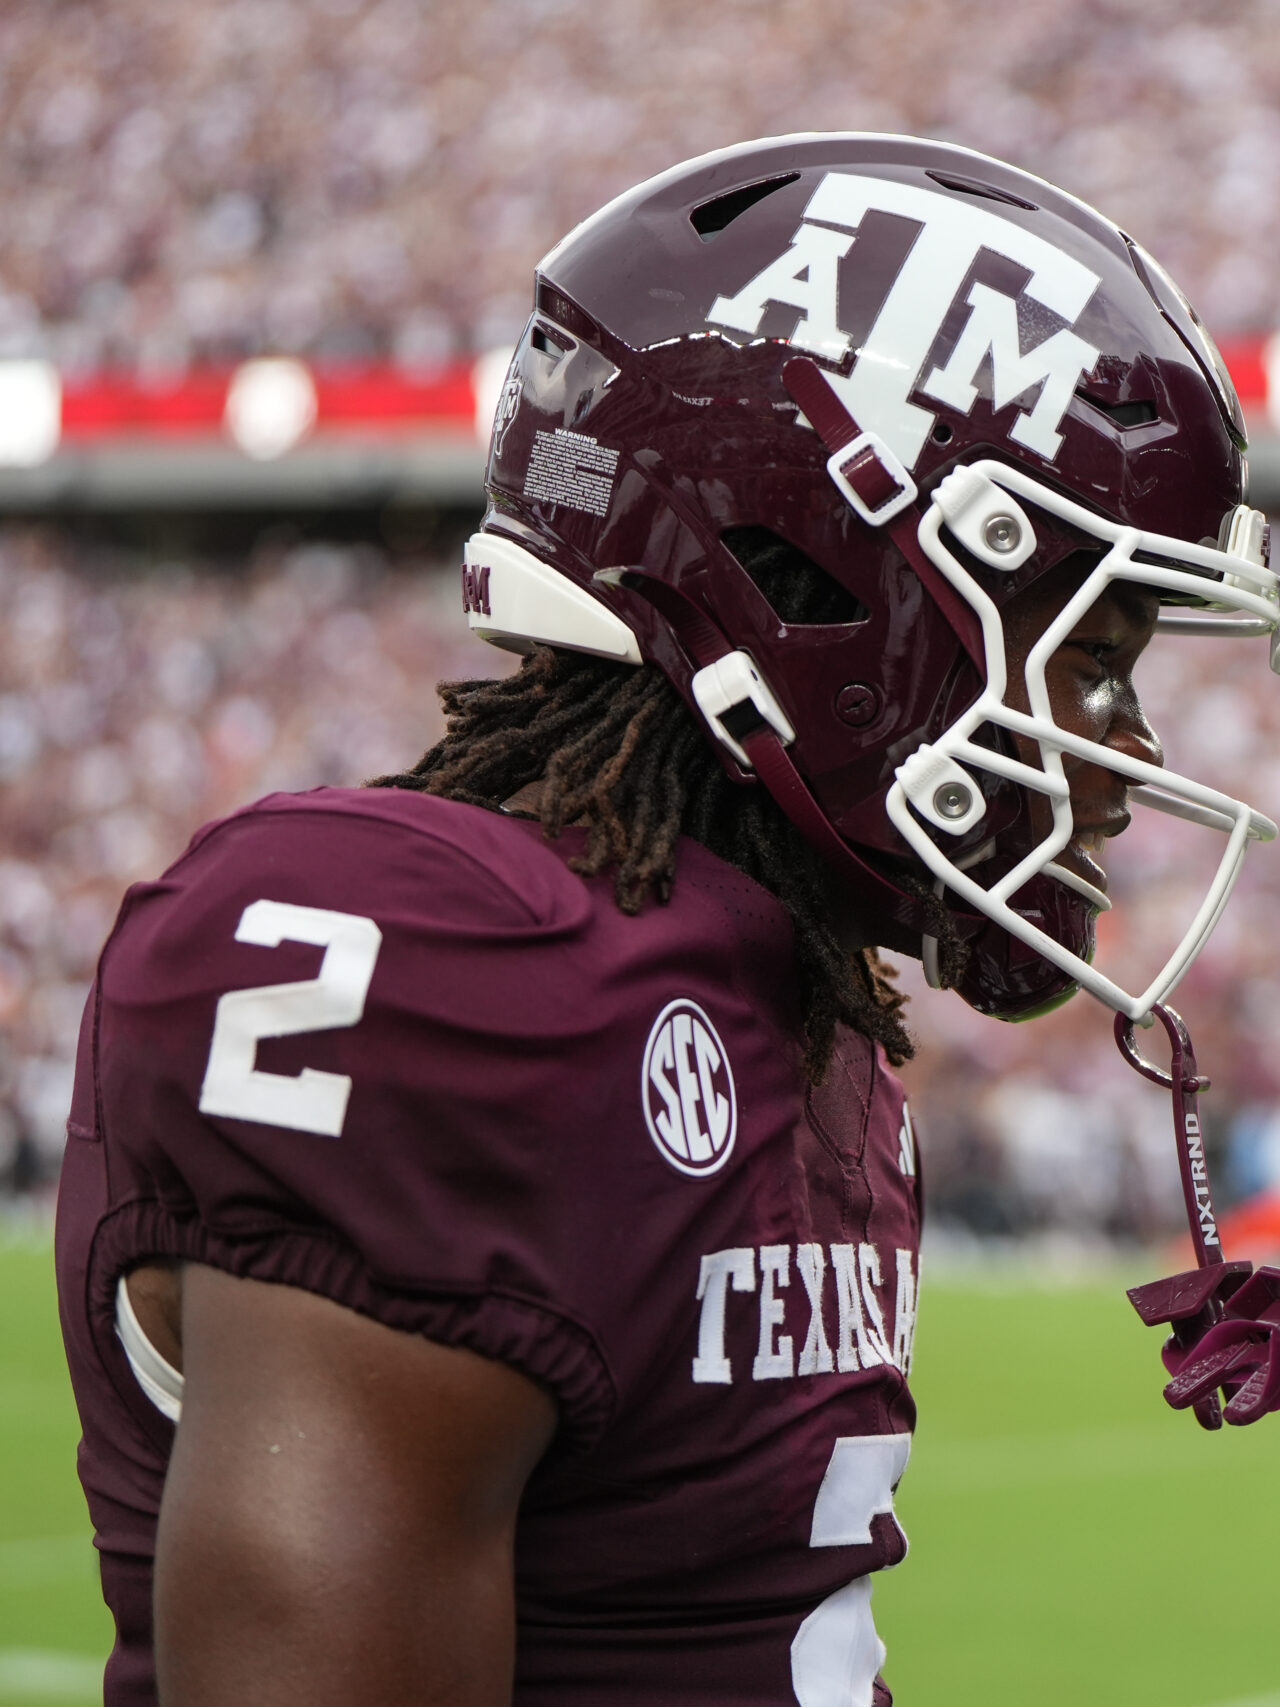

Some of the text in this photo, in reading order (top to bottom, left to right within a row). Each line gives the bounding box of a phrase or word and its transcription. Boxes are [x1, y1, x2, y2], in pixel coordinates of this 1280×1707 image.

[555, 427, 598, 445] WARNING
[199, 899, 383, 1138] 2
[650, 1013, 729, 1162] SEC
[1185, 1113, 1220, 1246] NXTRND
[692, 1242, 899, 1384] TEXAS
